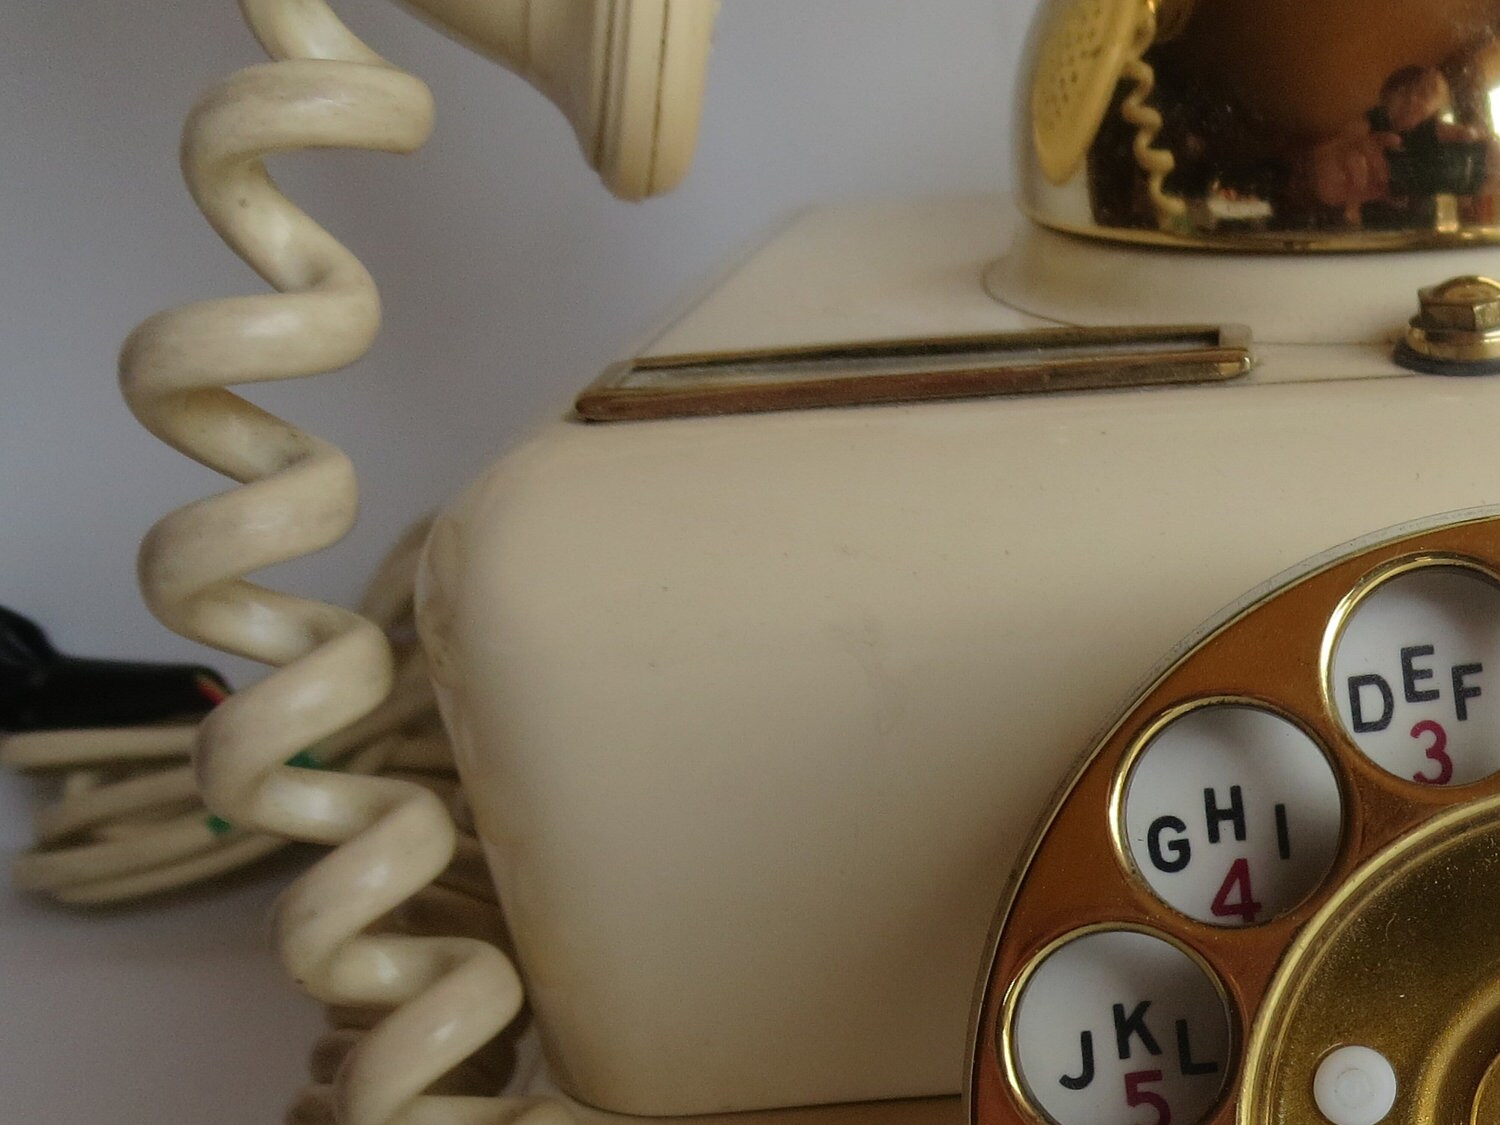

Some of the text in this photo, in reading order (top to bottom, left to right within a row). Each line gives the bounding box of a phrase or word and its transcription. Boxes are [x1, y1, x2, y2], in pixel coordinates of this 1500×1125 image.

[1347, 645, 1484, 734] DEF
[1409, 720, 1453, 785] 3
[1147, 785, 1290, 873] GHI
[1210, 858, 1262, 922] 4
[1059, 1001, 1218, 1090] JKL
